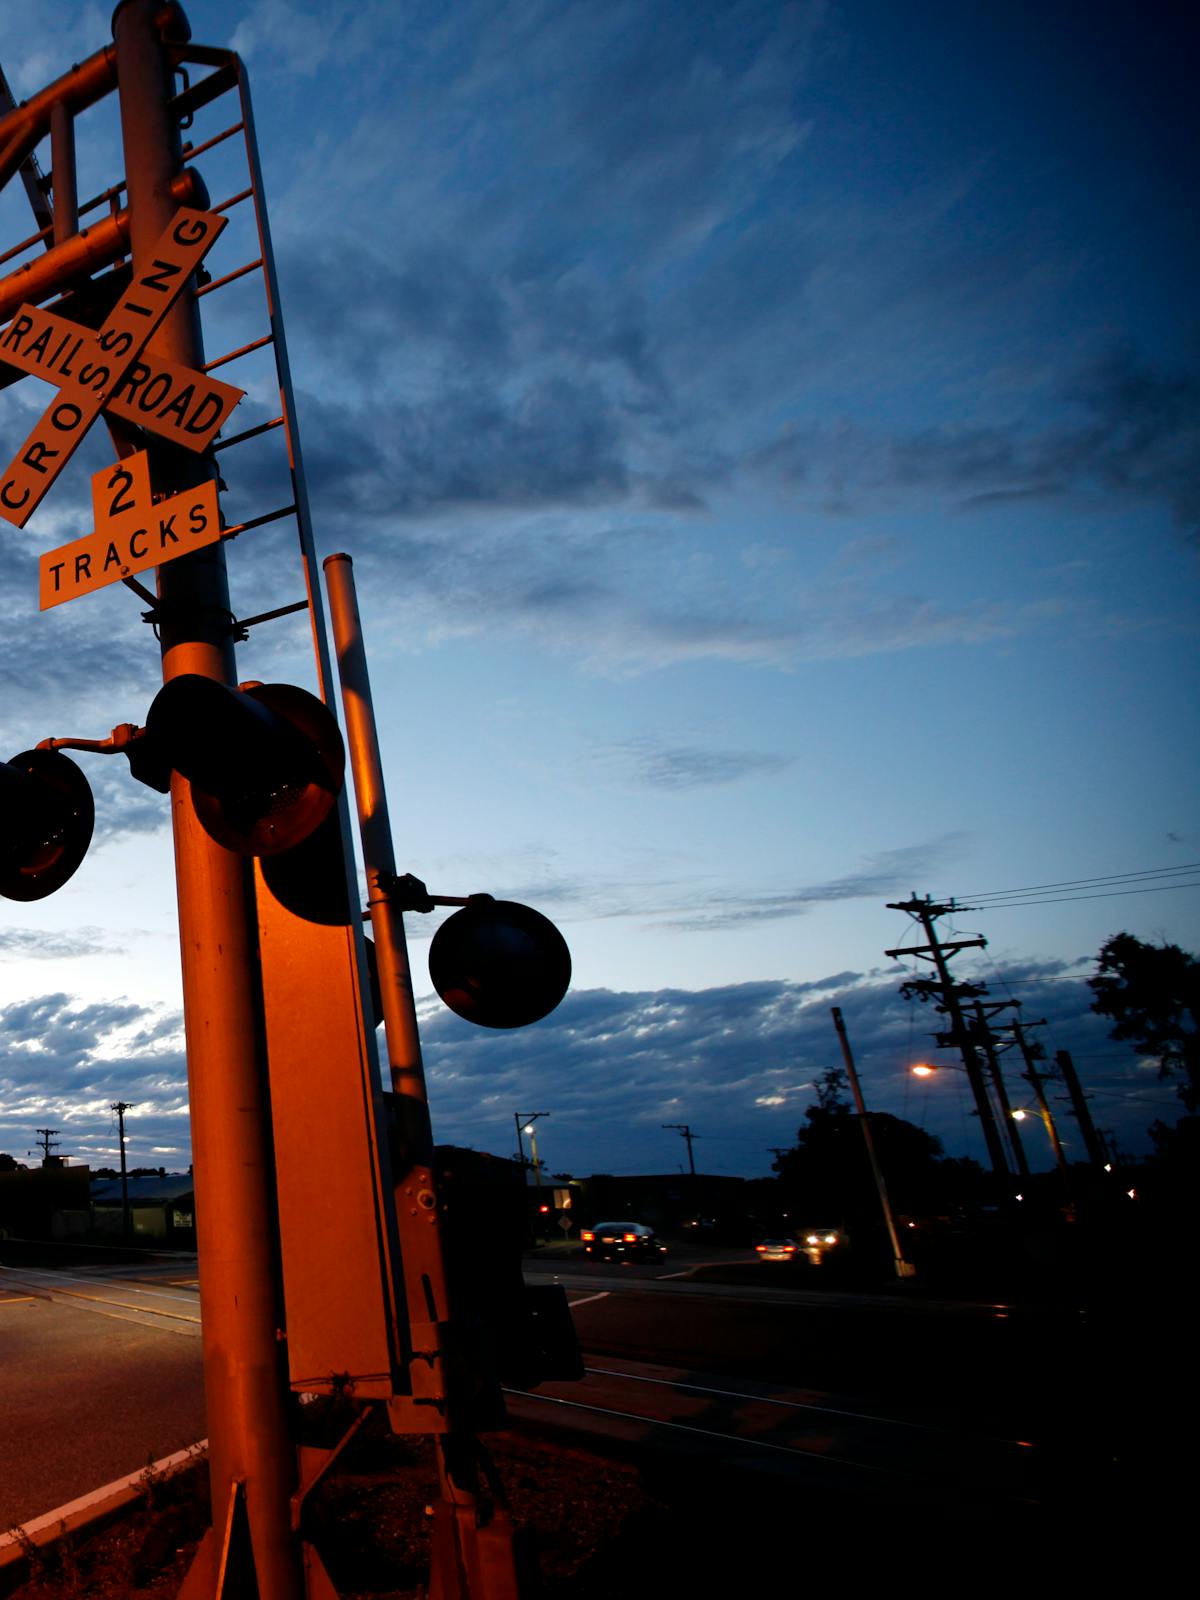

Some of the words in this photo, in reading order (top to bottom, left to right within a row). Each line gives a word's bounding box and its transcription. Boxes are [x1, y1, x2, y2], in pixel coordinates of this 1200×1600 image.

[1, 218, 208, 509] CROSSING
[3, 315, 84, 377] RAIL
[121, 361, 225, 434] ROAD
[108, 470, 136, 517] 2
[49, 503, 208, 592] TRACKS
